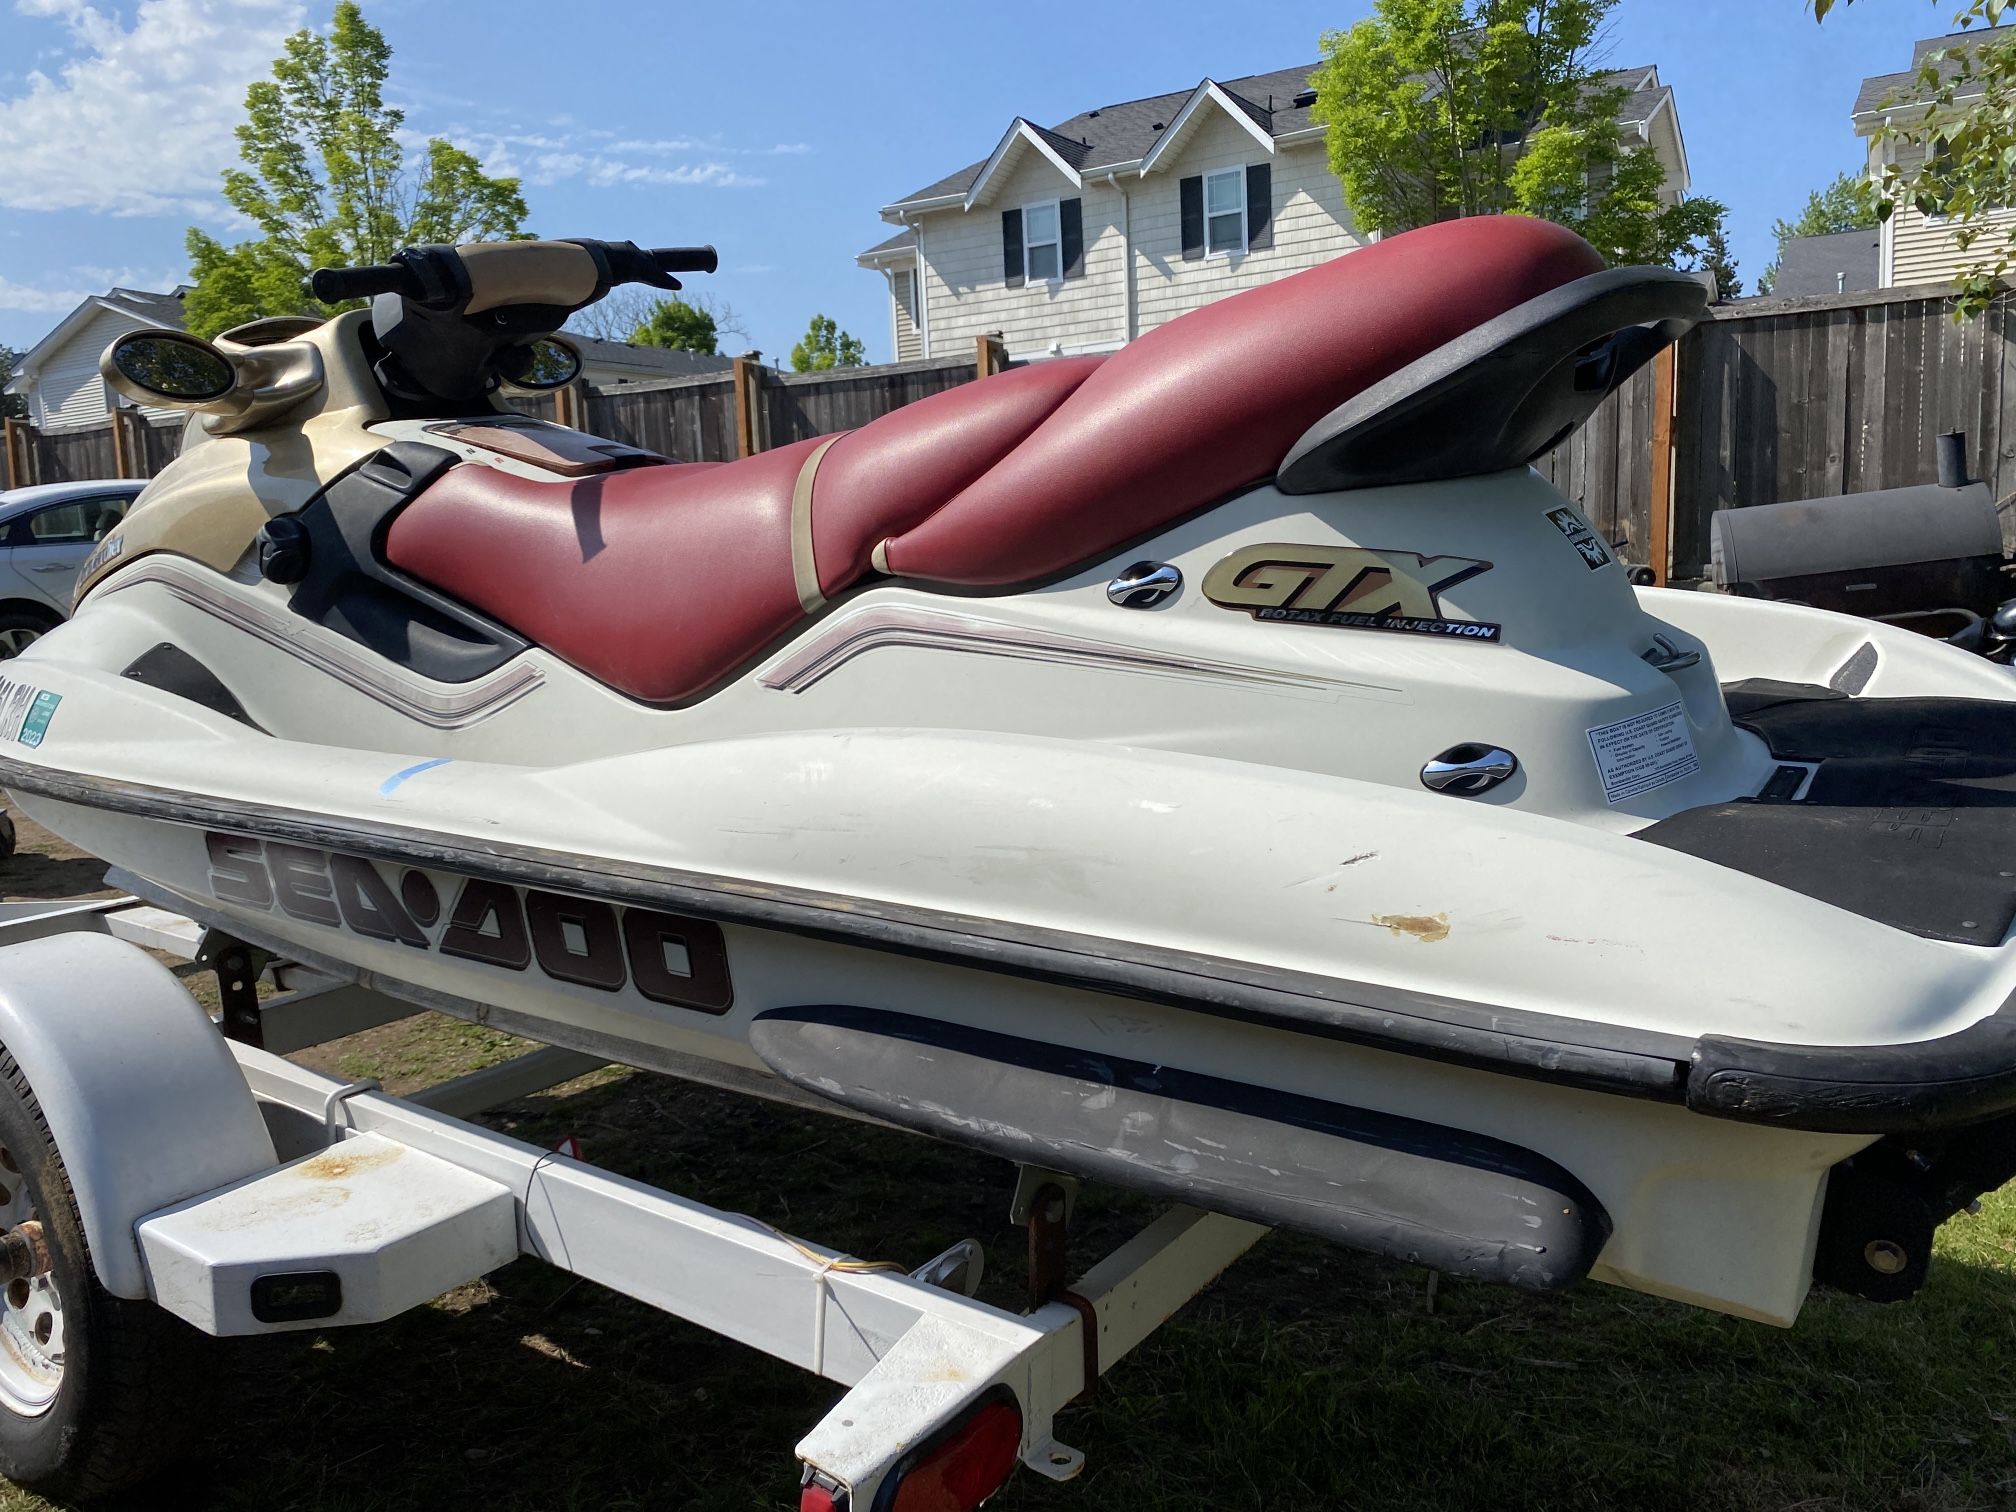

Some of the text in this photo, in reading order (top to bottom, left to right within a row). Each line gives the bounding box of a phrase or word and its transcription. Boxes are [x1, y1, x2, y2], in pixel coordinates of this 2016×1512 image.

[1202, 543, 1493, 620] GTX
[1258, 607, 1497, 638] ROTAX FUEL INJECTION
[20, 727, 42, 746] 2023
[1598, 731, 1625, 744] FOLLOWING
[1633, 724, 1646, 732] COAST
[1606, 739, 1623, 748] EFFECT
[1609, 767, 1635, 780] EXEMPTION
[1615, 759, 1641, 771] AUTHORIZED
